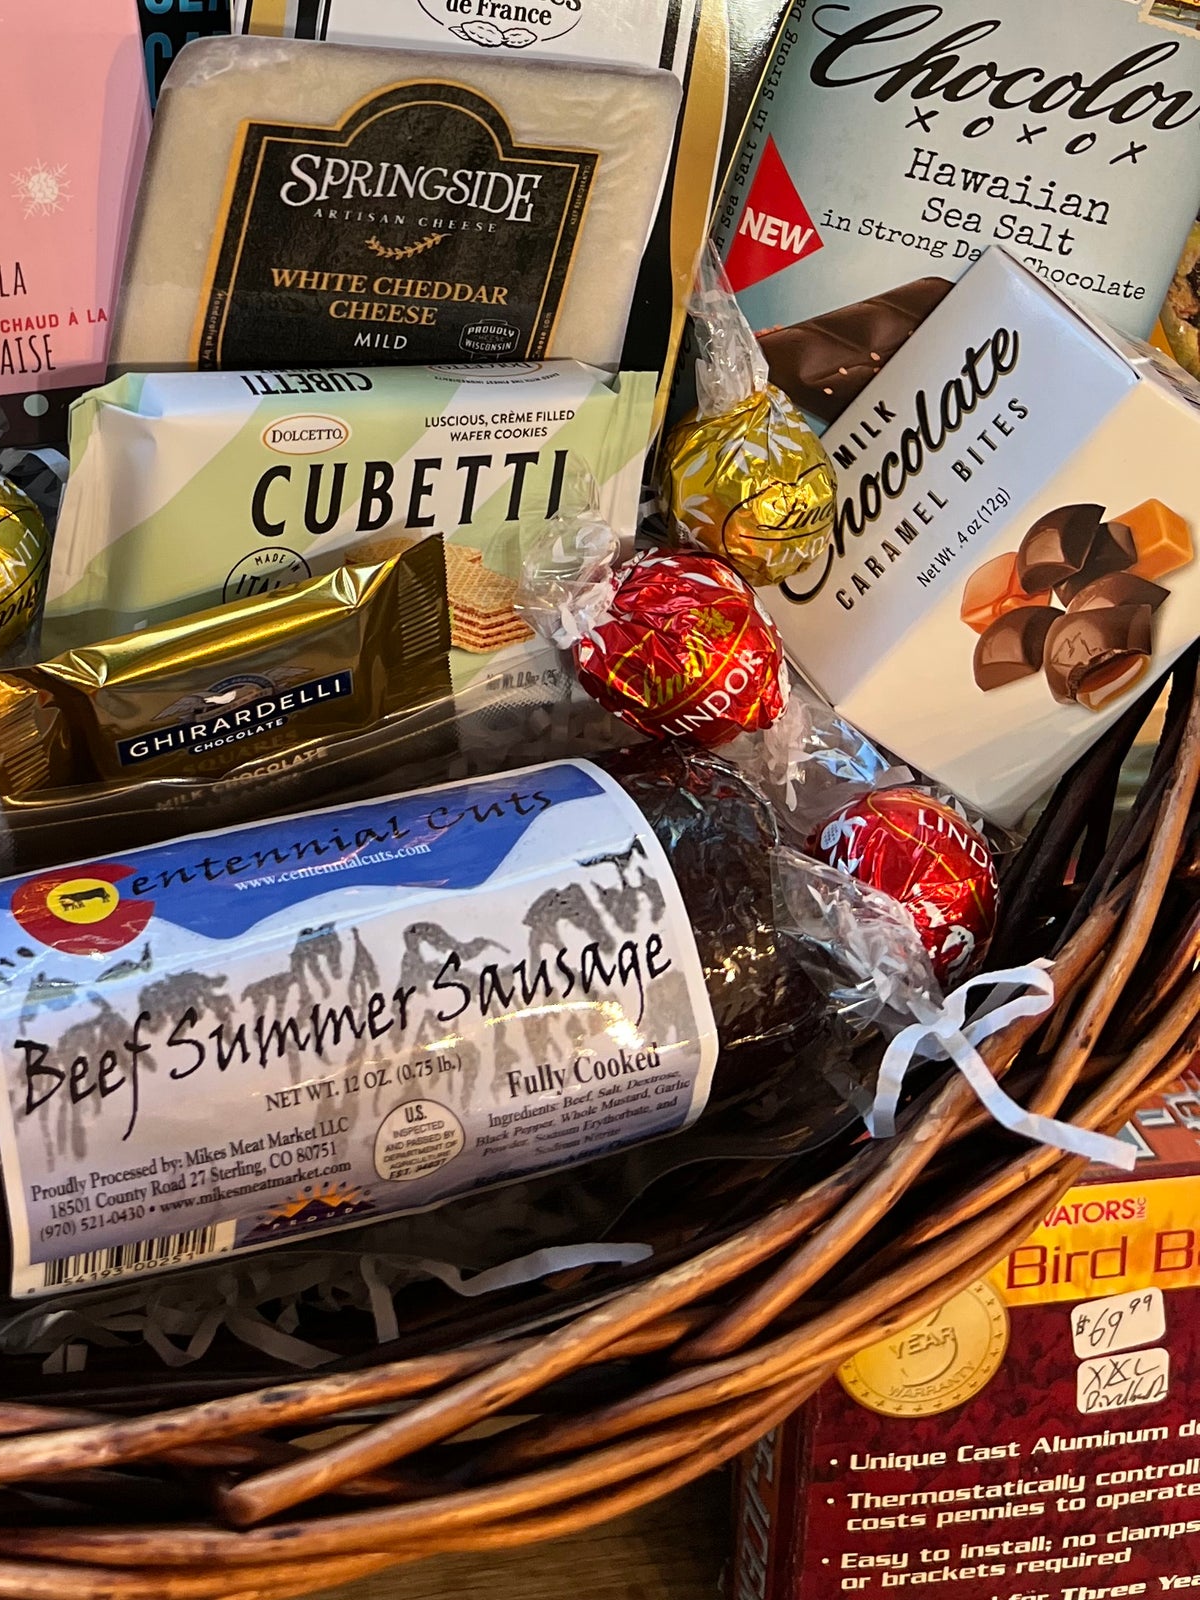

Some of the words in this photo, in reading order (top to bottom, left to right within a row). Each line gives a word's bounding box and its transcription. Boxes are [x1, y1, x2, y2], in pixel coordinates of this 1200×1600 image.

[280, 153, 542, 222] SPRINGSIDE
[903, 147, 1111, 226] Hawaiian
[313, 208, 406, 226] ARTISAN
[418, 217, 497, 233] CHEESE
[739, 207, 814, 255] NEW
[820, 208, 851, 232] in
[857, 218, 948, 259] Strong
[921, 198, 982, 233] Sea
[993, 215, 1075, 257] Salt
[270, 268, 368, 294] WHITE
[372, 276, 509, 306] CHEDDAR
[0, 313, 60, 334] CHAUD
[328, 300, 438, 326] CHEESE
[467, 325, 515, 338] PROUDLY
[353, 332, 408, 351] MILD
[464, 339, 512, 352] WISCONSIN
[424, 414, 488, 429] LUSCIOUS,
[491, 408, 533, 425] CRÈME
[536, 409, 576, 423] FILLED
[450, 429, 493, 442] WAFER
[495, 426, 548, 441] COOKIES
[833, 399, 899, 472] MILK
[251, 449, 570, 538] CUBETTI
[835, 490, 949, 612] CARAMEL
[951, 397, 1030, 483] BITES
[254, 553, 286, 566] MADE
[916, 561, 940, 588] Net
[935, 545, 957, 568] Wt
[976, 486, 1013, 525] (12g)
[129, 677, 343, 759] GHIRARDELLI
[660, 650, 764, 738] LINDOR
[193, 717, 285, 754] CHOCOLATE
[156, 788, 201, 813] MILK
[427, 788, 554, 832] Cuts
[235, 841, 432, 893] www.centennialcuts.com
[13, 1012, 153, 1142] Beef
[166, 982, 415, 1083] Summer
[432, 932, 673, 1029] Sausage
[265, 1090, 304, 1113] NET
[306, 1080, 341, 1103] WT.
[343, 1075, 360, 1096] 12
[363, 1068, 394, 1092] OZ.
[396, 1057, 434, 1086] (0.75
[437, 1052, 463, 1076] lb.)
[506, 1062, 567, 1099] Fully
[573, 1041, 662, 1086] Cooked
[31, 1177, 88, 1203] Proudly
[89, 1164, 159, 1193] Processed
[185, 1148, 228, 1170] Mikes
[230, 1139, 265, 1161] Meat
[267, 1127, 319, 1153] Market
[319, 1116, 351, 1138] LLC
[49, 1198, 94, 1220] 18501
[95, 1185, 149, 1213] County
[151, 1177, 188, 1200] Road
[209, 1158, 268, 1188] Sterling,
[296, 1140, 338, 1165] 80751
[1006, 1235, 1128, 1290] Bird
[889, 1326, 956, 1361] YEAR
[887, 1361, 975, 1398] WARRANTY
[850, 1449, 948, 1474] Unique
[956, 1441, 1020, 1463] Cast
[1031, 1426, 1169, 1455] Aluminum
[846, 1512, 927, 1532] costs
[936, 1501, 1045, 1529] pennies
[1056, 1496, 1087, 1513] to
[847, 1473, 1086, 1511] Thermostatically
[840, 1575, 871, 1591] or
[881, 1563, 1006, 1588] brackets
[1015, 1547, 1133, 1575] required
[841, 1551, 909, 1571] Easy
[919, 1547, 950, 1564] to
[960, 1536, 1053, 1560] install;
[1062, 1532, 1097, 1549] no
[1106, 1519, 1200, 1540] clamps
